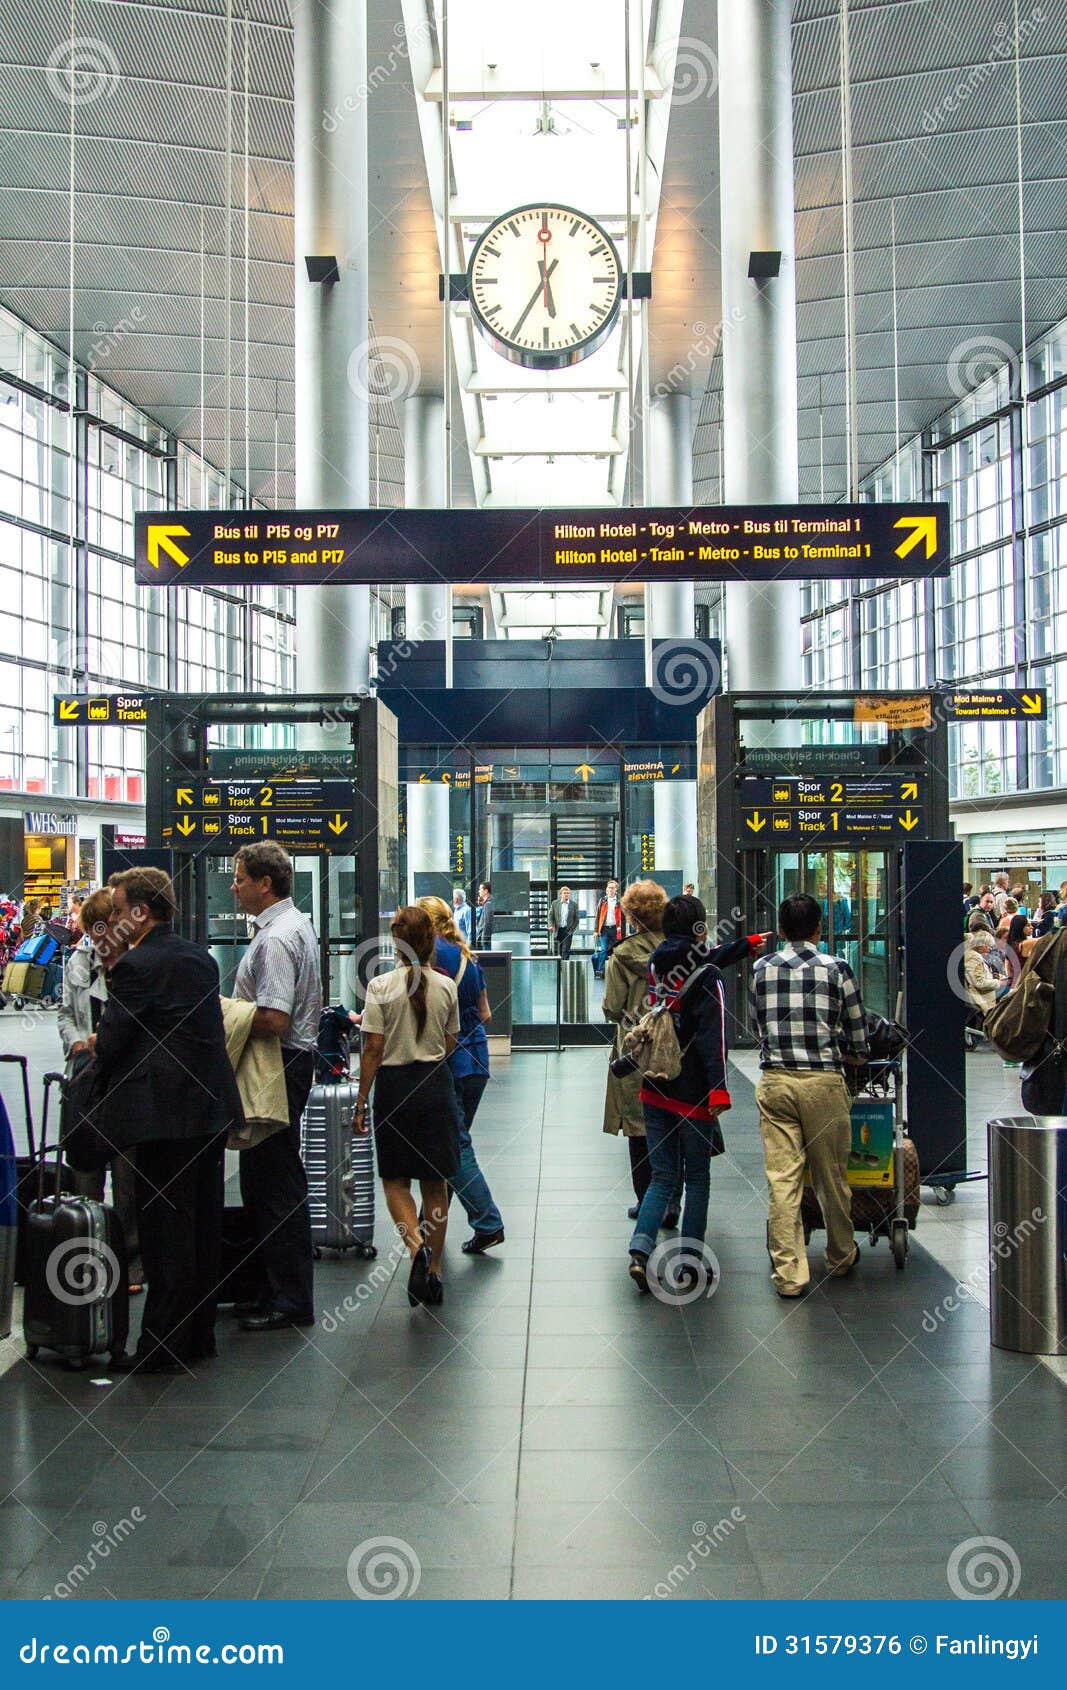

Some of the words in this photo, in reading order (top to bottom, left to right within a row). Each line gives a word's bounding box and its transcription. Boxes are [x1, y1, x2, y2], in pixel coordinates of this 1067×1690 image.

[213, 525, 240, 539] Bus
[243, 525, 258, 539] til
[266, 524, 291, 539] P15
[293, 527, 313, 541] og
[316, 524, 340, 538] P17
[554, 524, 596, 539] Hilton
[599, 523, 637, 538] Hotel
[648, 522, 675, 539] Tog
[688, 521, 730, 535] Metro
[743, 520, 771, 534] Bus
[773, 519, 788, 533] til
[791, 518, 851, 533] Terminal
[854, 518, 861, 532] 1
[213, 550, 241, 565] Bus
[243, 551, 259, 564] to
[262, 550, 287, 564] P15
[290, 550, 318, 564] and
[321, 549, 345, 564] P17
[555, 550, 596, 564] Hilton
[600, 548, 637, 563] Hotel
[649, 547, 685, 562] Train
[698, 546, 740, 560] Metro
[753, 545, 781, 559] Bus
[783, 546, 799, 559] to
[801, 544, 861, 559] Terminal
[864, 543, 871, 557] 1
[116, 696, 143, 709] Spor
[996, 695, 1003, 703] C
[116, 708, 147, 720] Track
[955, 707, 980, 715] Toward
[1010, 707, 1017, 715] C
[228, 786, 251, 798] Spor
[797, 781, 822, 793] Spor
[797, 793, 825, 803] Track
[830, 783, 844, 802] 2
[228, 797, 255, 807] Track
[259, 787, 273, 806] 2
[30, 812, 77, 834] WHSmith
[228, 814, 251, 826] Spor
[798, 810, 822, 822] Spor
[798, 822, 826, 831] Track
[830, 812, 839, 831] 1
[228, 825, 255, 836] Track
[260, 815, 268, 835] 1
